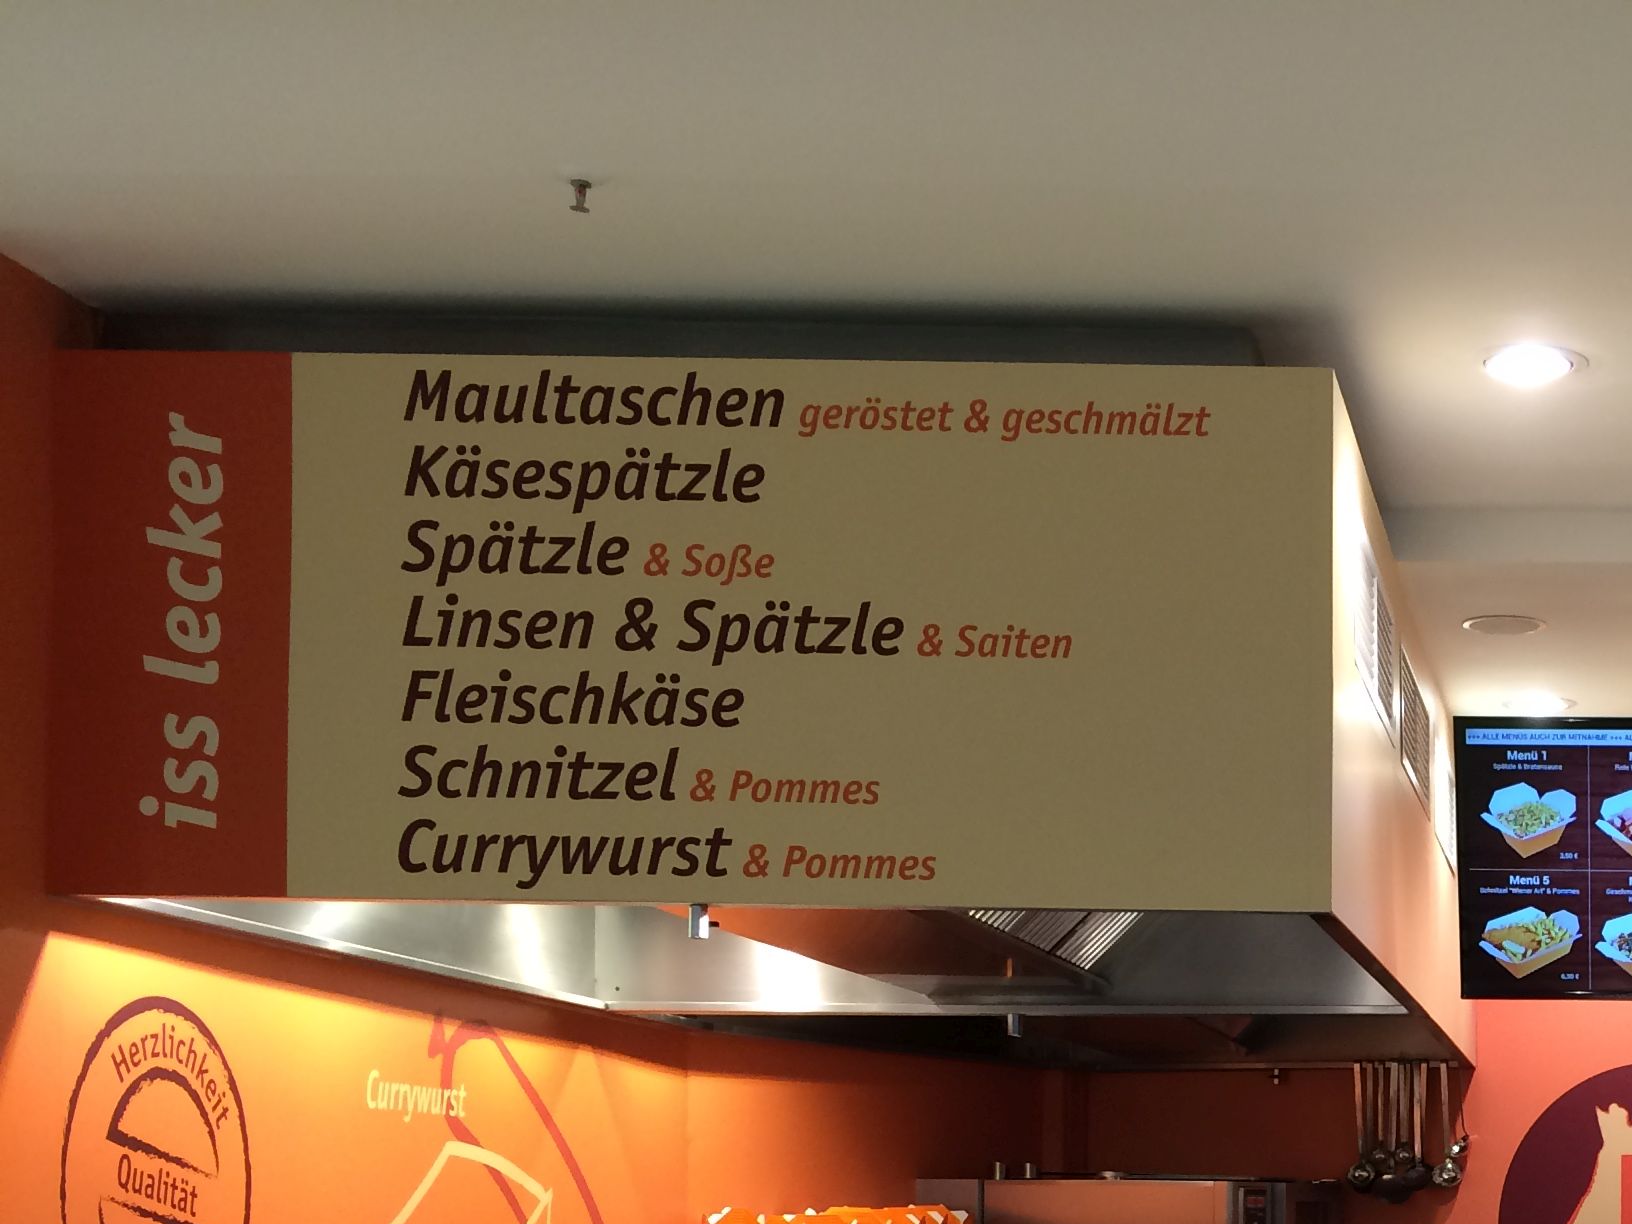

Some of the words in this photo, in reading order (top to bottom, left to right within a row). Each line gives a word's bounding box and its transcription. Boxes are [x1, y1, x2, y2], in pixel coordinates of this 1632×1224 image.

[404, 369, 787, 429] Maultaschen
[800, 398, 952, 436] geröstet
[965, 402, 991, 433] &
[1001, 400, 1211, 438] geschmälzt
[403, 443, 766, 517] Käsespätzle
[145, 413, 227, 686] lecker
[401, 520, 630, 586] Spätzle
[644, 546, 671, 577] &
[682, 541, 775, 585] Soße
[402, 597, 594, 651] Linsen
[615, 597, 656, 651] &
[676, 600, 905, 666] Spätzle
[917, 626, 944, 658] &
[955, 622, 1073, 660] Saiten
[401, 668, 746, 729] Fleischkäse
[139, 715, 221, 830] iss
[398, 745, 679, 802] Schnitzel
[690, 769, 717, 802] &
[729, 768, 881, 805] Pommes
[1507, 751, 1538, 761] Menü
[1541, 751, 1547, 761] 1
[398, 821, 733, 888] Currywurst
[742, 843, 769, 877] &
[782, 842, 938, 880] Pommes
[1509, 876, 1540, 885] Menü
[1543, 876, 1550, 885] 5
[110, 1021, 230, 1132] Herzlichkeit
[366, 1069, 466, 1121] Currywurst
[116, 1152, 198, 1218] Qualität
